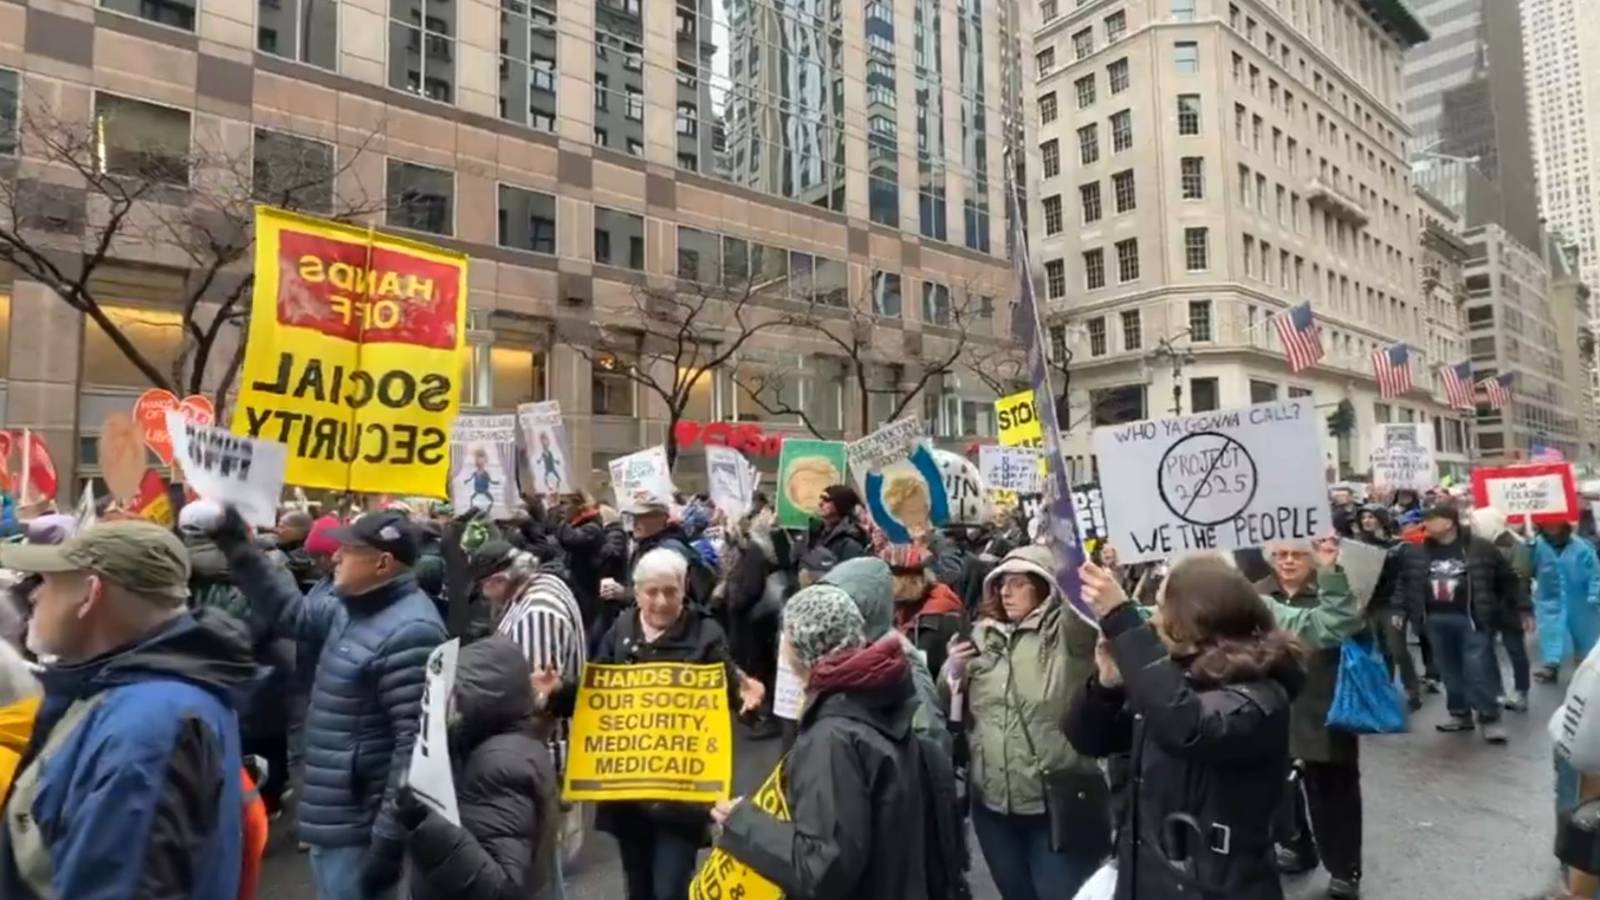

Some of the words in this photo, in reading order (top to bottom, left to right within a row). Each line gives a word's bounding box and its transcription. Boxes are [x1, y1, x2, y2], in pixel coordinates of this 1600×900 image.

[1114, 421, 1157, 444] WHO
[1160, 418, 1185, 437] YA
[1184, 414, 1241, 434] GONNA
[1249, 403, 1301, 426] CALL?
[1165, 446, 1242, 475] PROJECT
[1174, 473, 1248, 500] 2025
[1131, 523, 1171, 554] WE
[1178, 523, 1216, 550] THE
[1233, 507, 1318, 547] PEOPLE
[593, 668, 672, 688] HANDS
[679, 667, 721, 687] OFF
[588, 693, 634, 710] OUR
[640, 692, 719, 710] SOCIAL
[598, 714, 709, 733] SECURITY,
[585, 735, 698, 753] MEDICARE
[706, 738, 718, 753] &
[595, 756, 705, 775] MEDICAID
